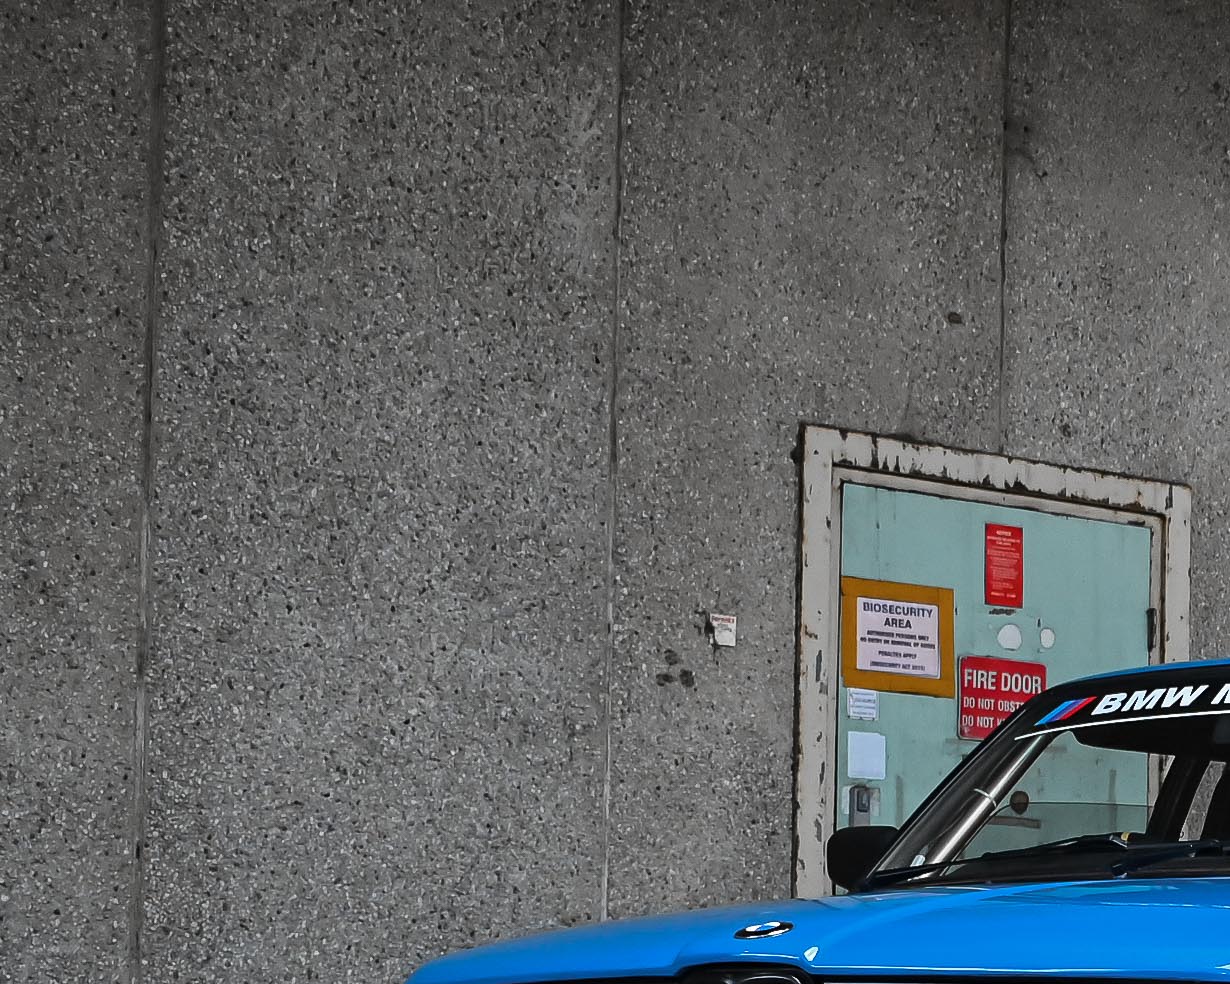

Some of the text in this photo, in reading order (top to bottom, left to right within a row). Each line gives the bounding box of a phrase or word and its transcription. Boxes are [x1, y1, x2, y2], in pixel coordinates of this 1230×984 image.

[863, 602, 933, 618] BIOSECURITY
[884, 617, 912, 629] AREA
[964, 668, 1042, 694] FIRE DOOR
[963, 696, 1025, 713] DO NOT OBST
[1091, 685, 1210, 716] BMW
[962, 715, 974, 727] DO
[976, 716, 995, 728] NOT
